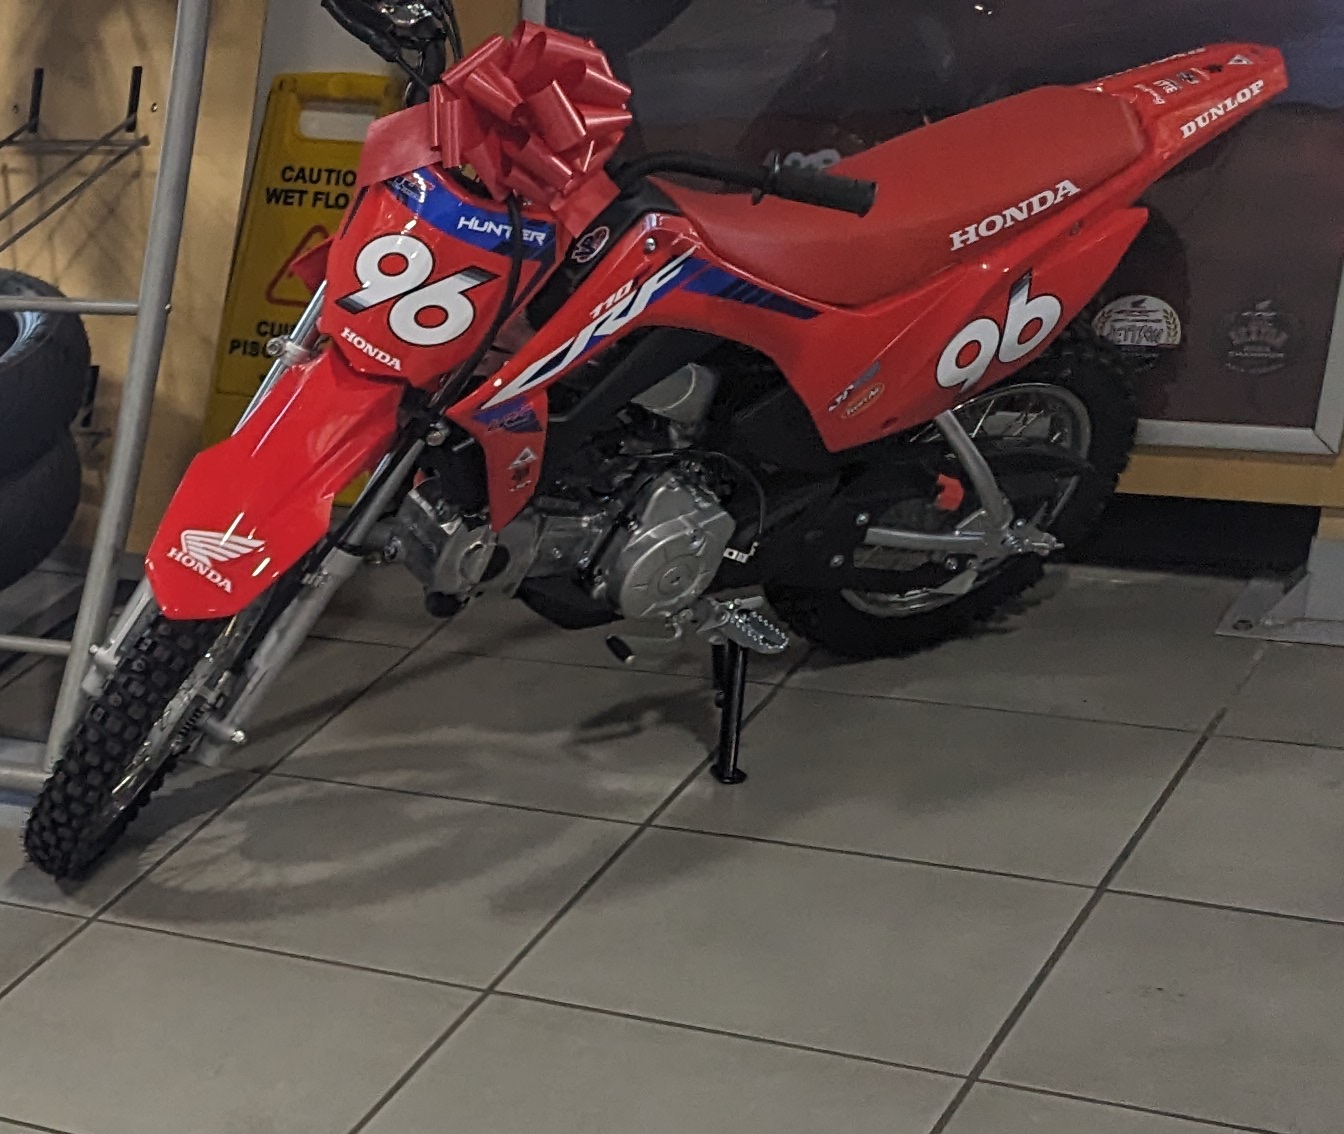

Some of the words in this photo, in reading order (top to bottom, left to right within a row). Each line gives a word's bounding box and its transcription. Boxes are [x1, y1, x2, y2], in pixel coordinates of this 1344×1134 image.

[1180, 79, 1264, 138] DUNLOP
[265, 188, 308, 207] WET
[311, 192, 349, 209] FLO
[281, 166, 357, 187] CAUTIO
[949, 180, 1081, 251] HONDA
[335, 234, 502, 347] 96
[590, 279, 634, 319] 110
[340, 327, 403, 372] HONDA
[936, 267, 1062, 391] 96
[166, 547, 232, 593] HONDA
